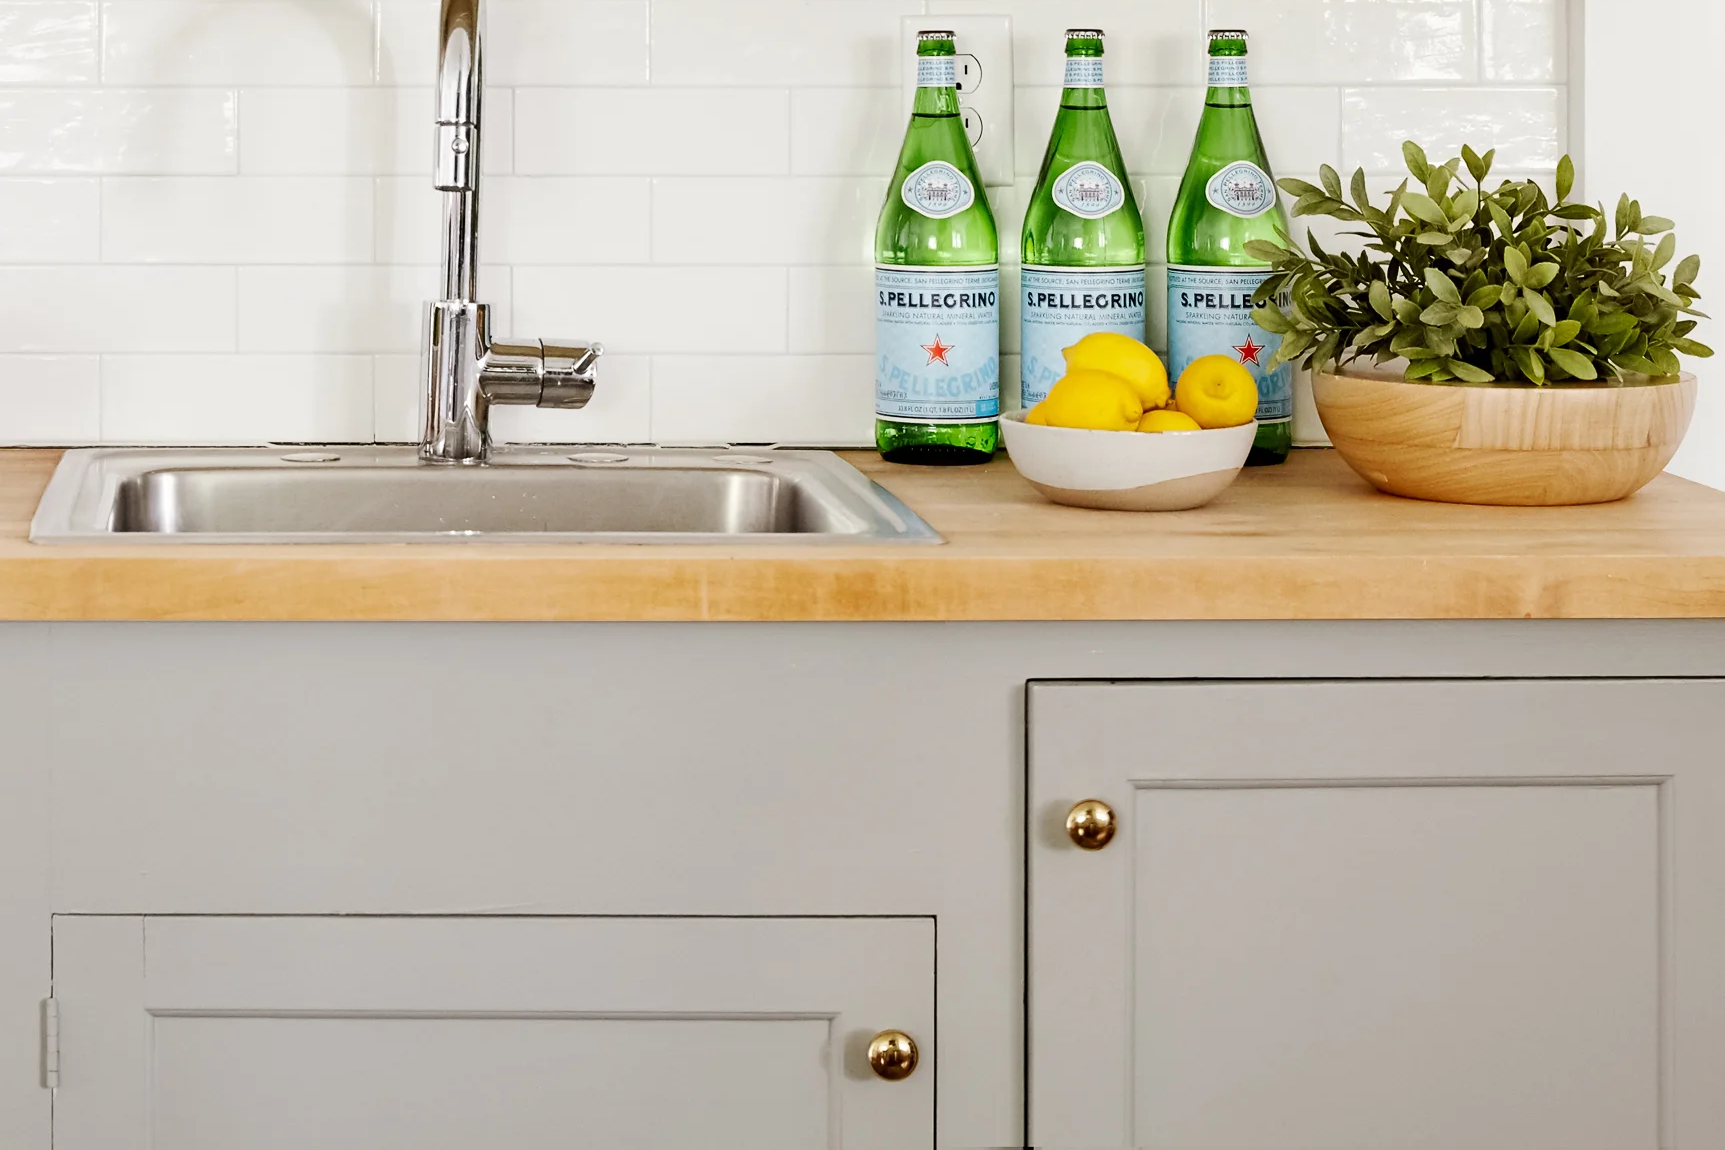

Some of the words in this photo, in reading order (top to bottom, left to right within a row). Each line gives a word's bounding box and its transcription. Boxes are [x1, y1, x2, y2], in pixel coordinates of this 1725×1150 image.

[928, 277, 963, 285] PELLEGRINO
[1240, 277, 1263, 285] PELLEGR
[879, 291, 996, 309] S.PELLEGRINO
[1027, 291, 1144, 309] S.PELLEGRINO
[882, 311, 911, 319] SPARKLING
[913, 312, 944, 320] NATURAL
[946, 312, 975, 320] MINERAL
[977, 311, 993, 319] WATER
[1030, 311, 1062, 320] SPARKLING
[1099, 312, 1127, 320] MINERAL
[1185, 311, 1221, 320] SPARKLING
[1223, 312, 1252, 320] NATURA
